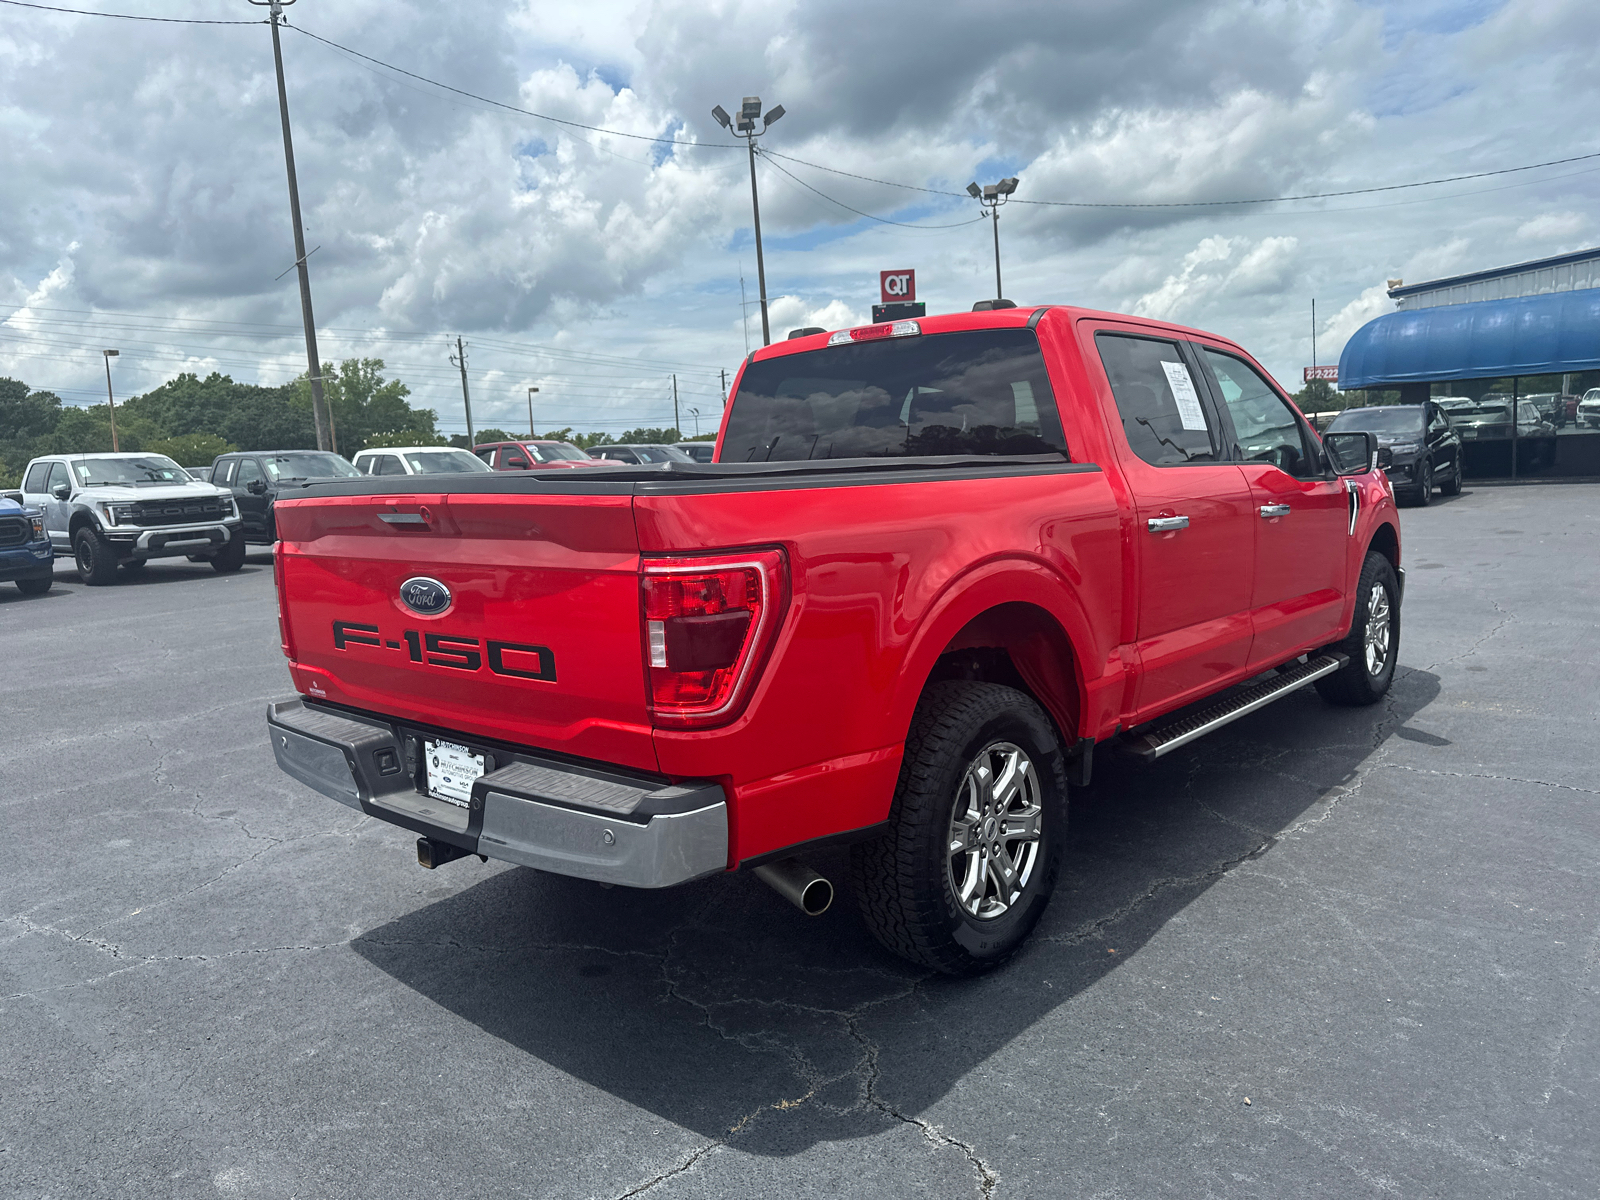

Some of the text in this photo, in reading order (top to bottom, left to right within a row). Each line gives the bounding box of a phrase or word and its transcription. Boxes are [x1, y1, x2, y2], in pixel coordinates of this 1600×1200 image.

[884, 274, 911, 296] QT
[408, 584, 436, 607] Ford
[332, 619, 558, 684] F-150
